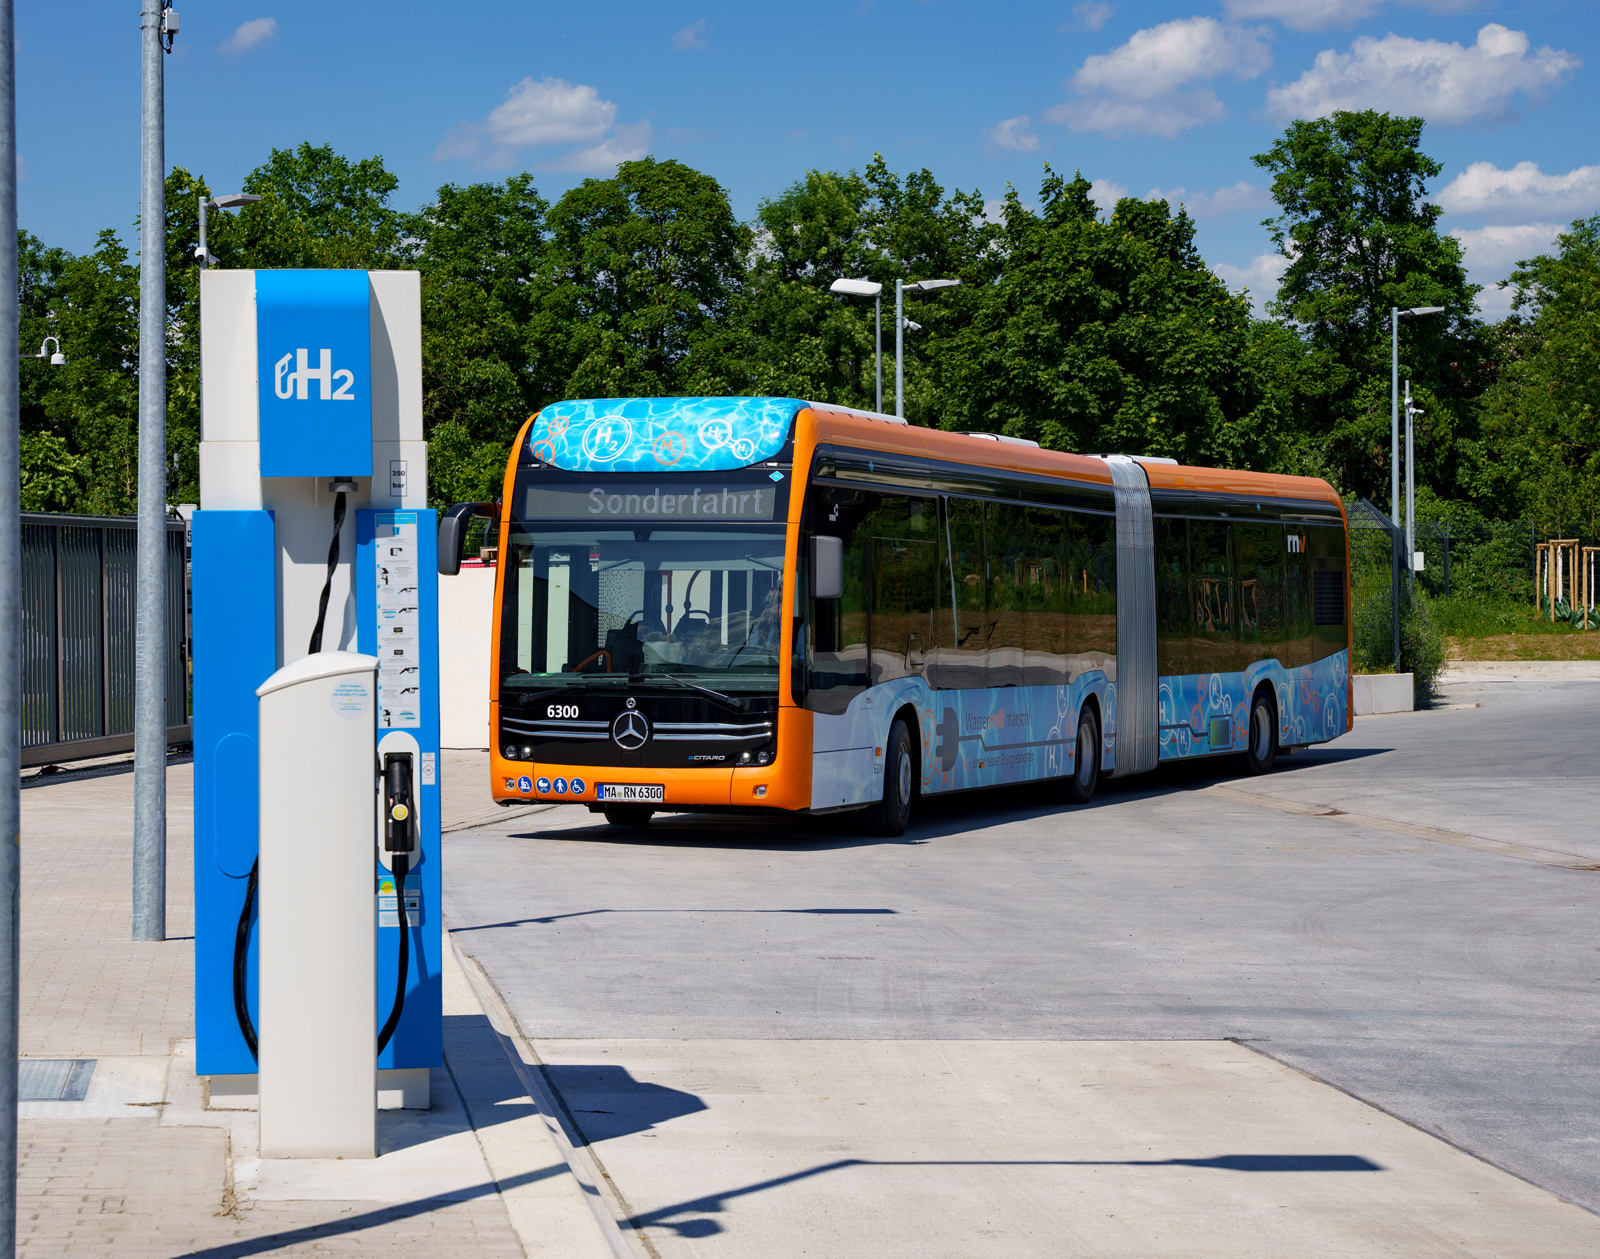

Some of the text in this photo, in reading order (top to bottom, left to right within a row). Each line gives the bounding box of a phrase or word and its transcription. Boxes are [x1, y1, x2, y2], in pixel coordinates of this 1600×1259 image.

[296, 348, 355, 400] H2
[594, 426, 617, 451] H2
[707, 426, 723, 442] H2
[661, 439, 676, 457] H2
[392, 481, 405, 489] bar
[588, 488, 763, 515] Sonderfahrt
[547, 705, 579, 718] 6300
[965, 707, 1031, 731] Wasserstoff marsch!
[604, 786, 662, 799] MA RN 6300
